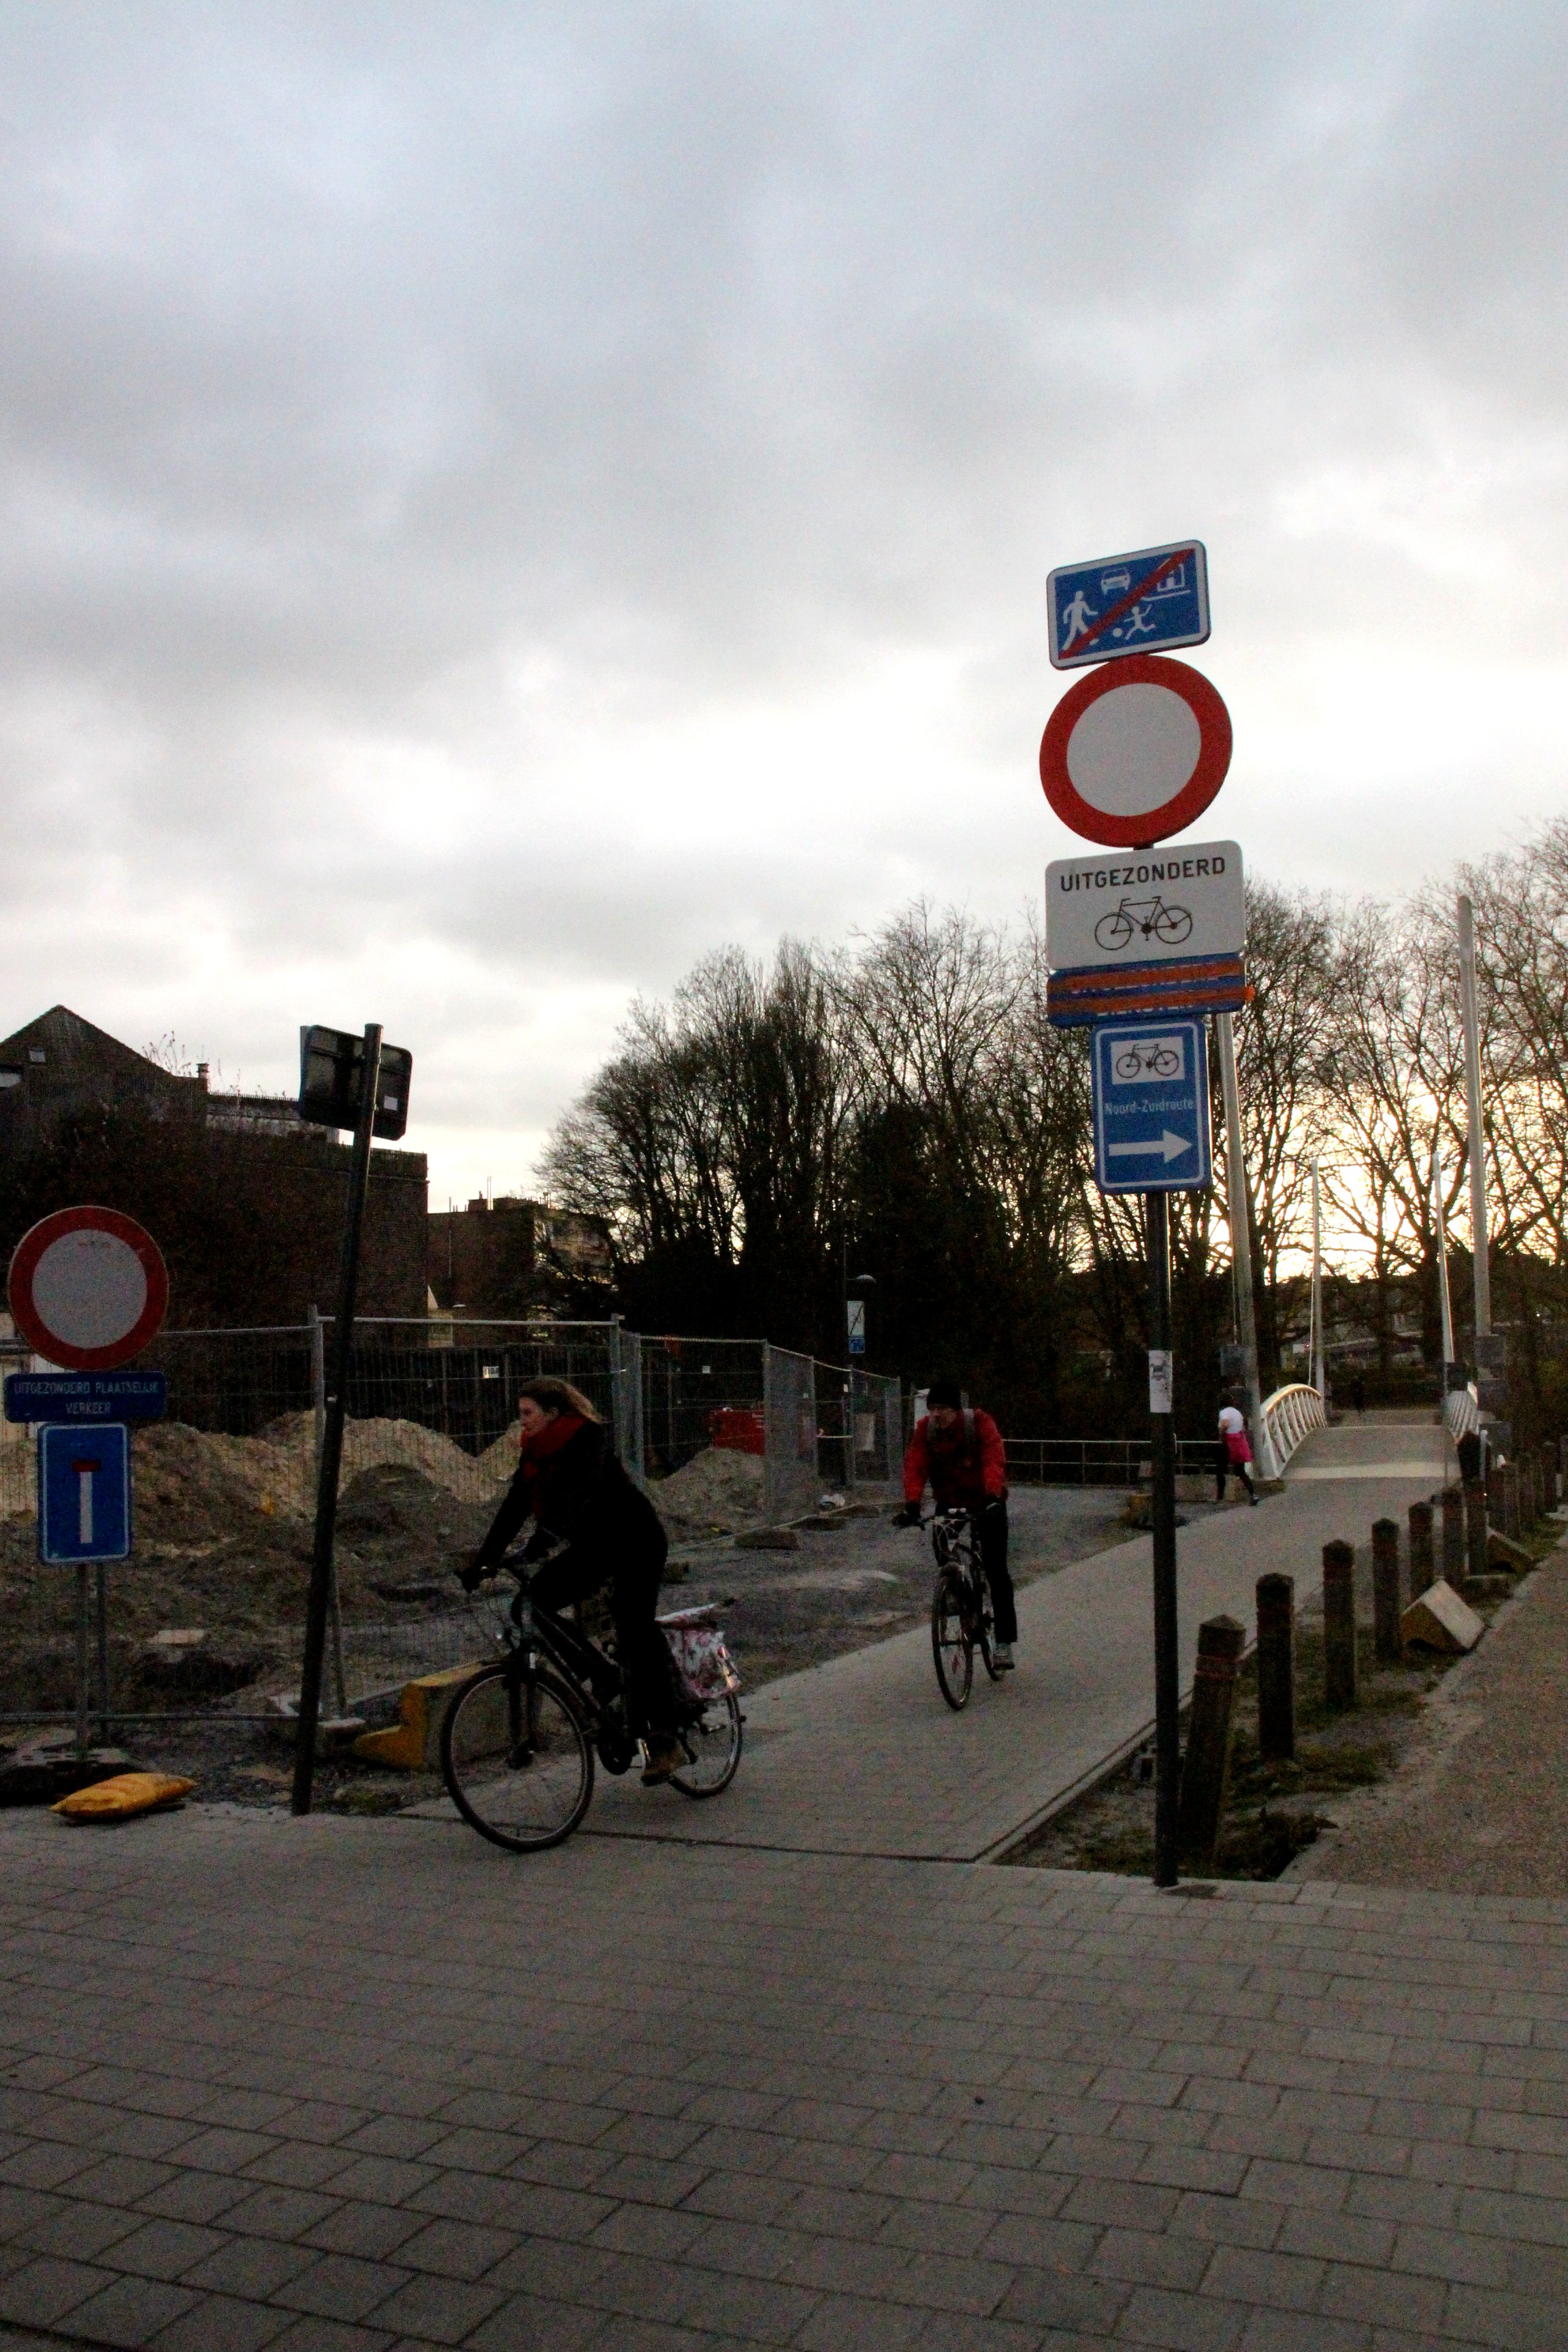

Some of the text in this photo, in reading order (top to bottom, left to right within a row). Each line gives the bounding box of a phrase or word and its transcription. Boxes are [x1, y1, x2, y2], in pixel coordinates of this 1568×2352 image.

[1060, 856, 1226, 892] UITGEZONDERD
[1104, 1098, 1194, 1115] Noord-Zuidroute
[14, 1381, 91, 1395] UITGEZONDERD
[65, 1401, 112, 1415] VERKEER
